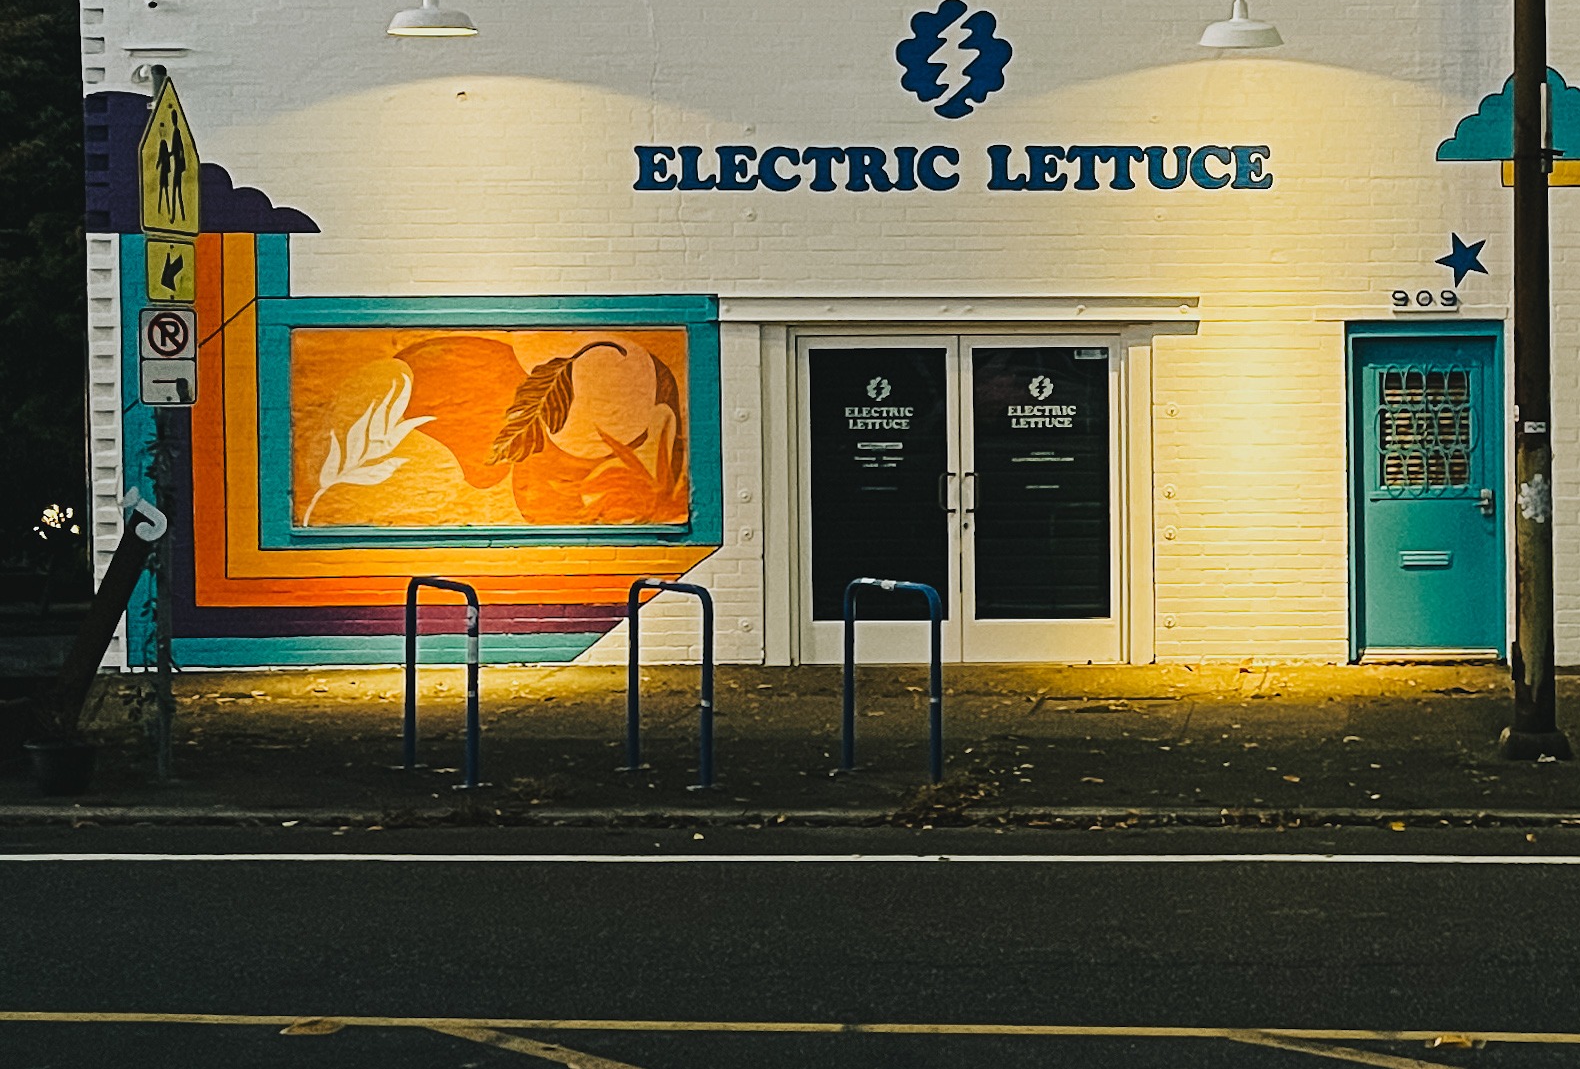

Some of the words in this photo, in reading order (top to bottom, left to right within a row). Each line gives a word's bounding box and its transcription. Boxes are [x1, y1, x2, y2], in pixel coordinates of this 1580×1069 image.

[633, 144, 960, 191] ELECTRIC
[987, 144, 1274, 191] LETTUCE
[1391, 290, 1458, 306] 909
[844, 406, 914, 418] ELECTRIC
[1007, 405, 1077, 416] ELECTRIC
[848, 419, 910, 430] LETTUCE
[1011, 417, 1073, 428] LETTUCE
